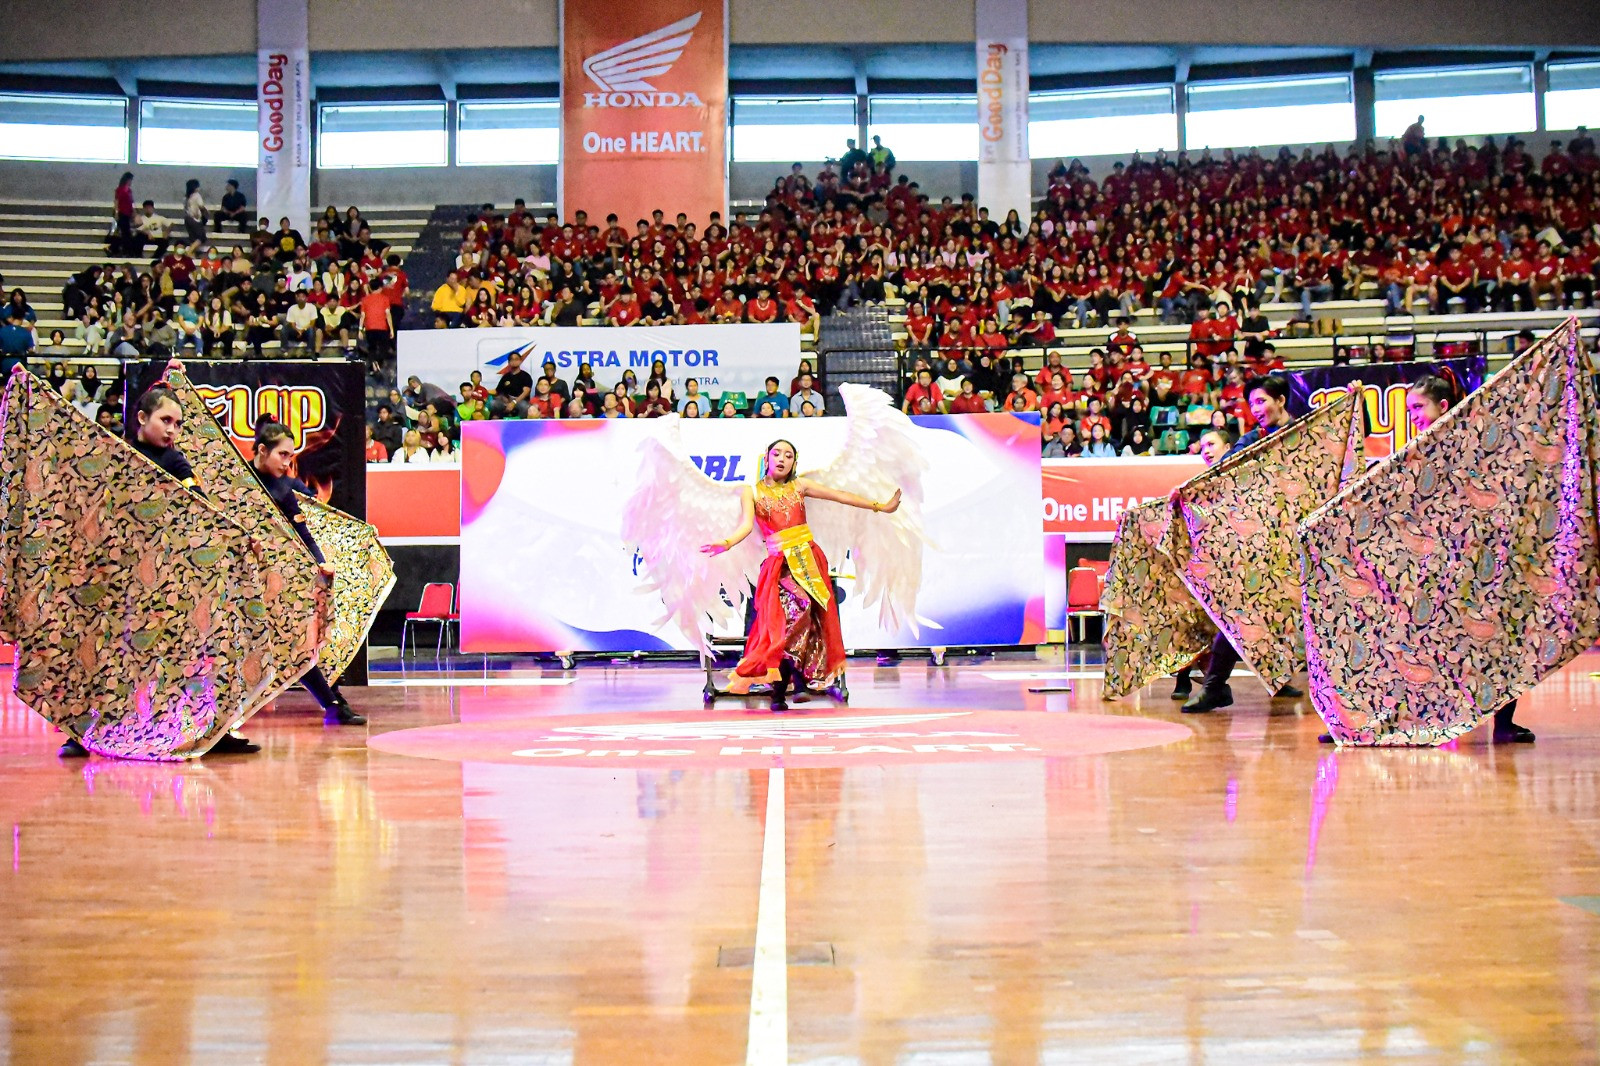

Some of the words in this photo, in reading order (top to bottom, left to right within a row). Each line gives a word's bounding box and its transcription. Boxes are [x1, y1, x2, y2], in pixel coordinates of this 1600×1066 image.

[583, 92, 705, 108] HONDA
[583, 131, 627, 154] One
[631, 131, 706, 153] HEART.
[541, 350, 621, 367] ASTRA
[629, 349, 719, 367] MOTOR
[1043, 497, 1087, 521] One
[511, 747, 696, 758] One
